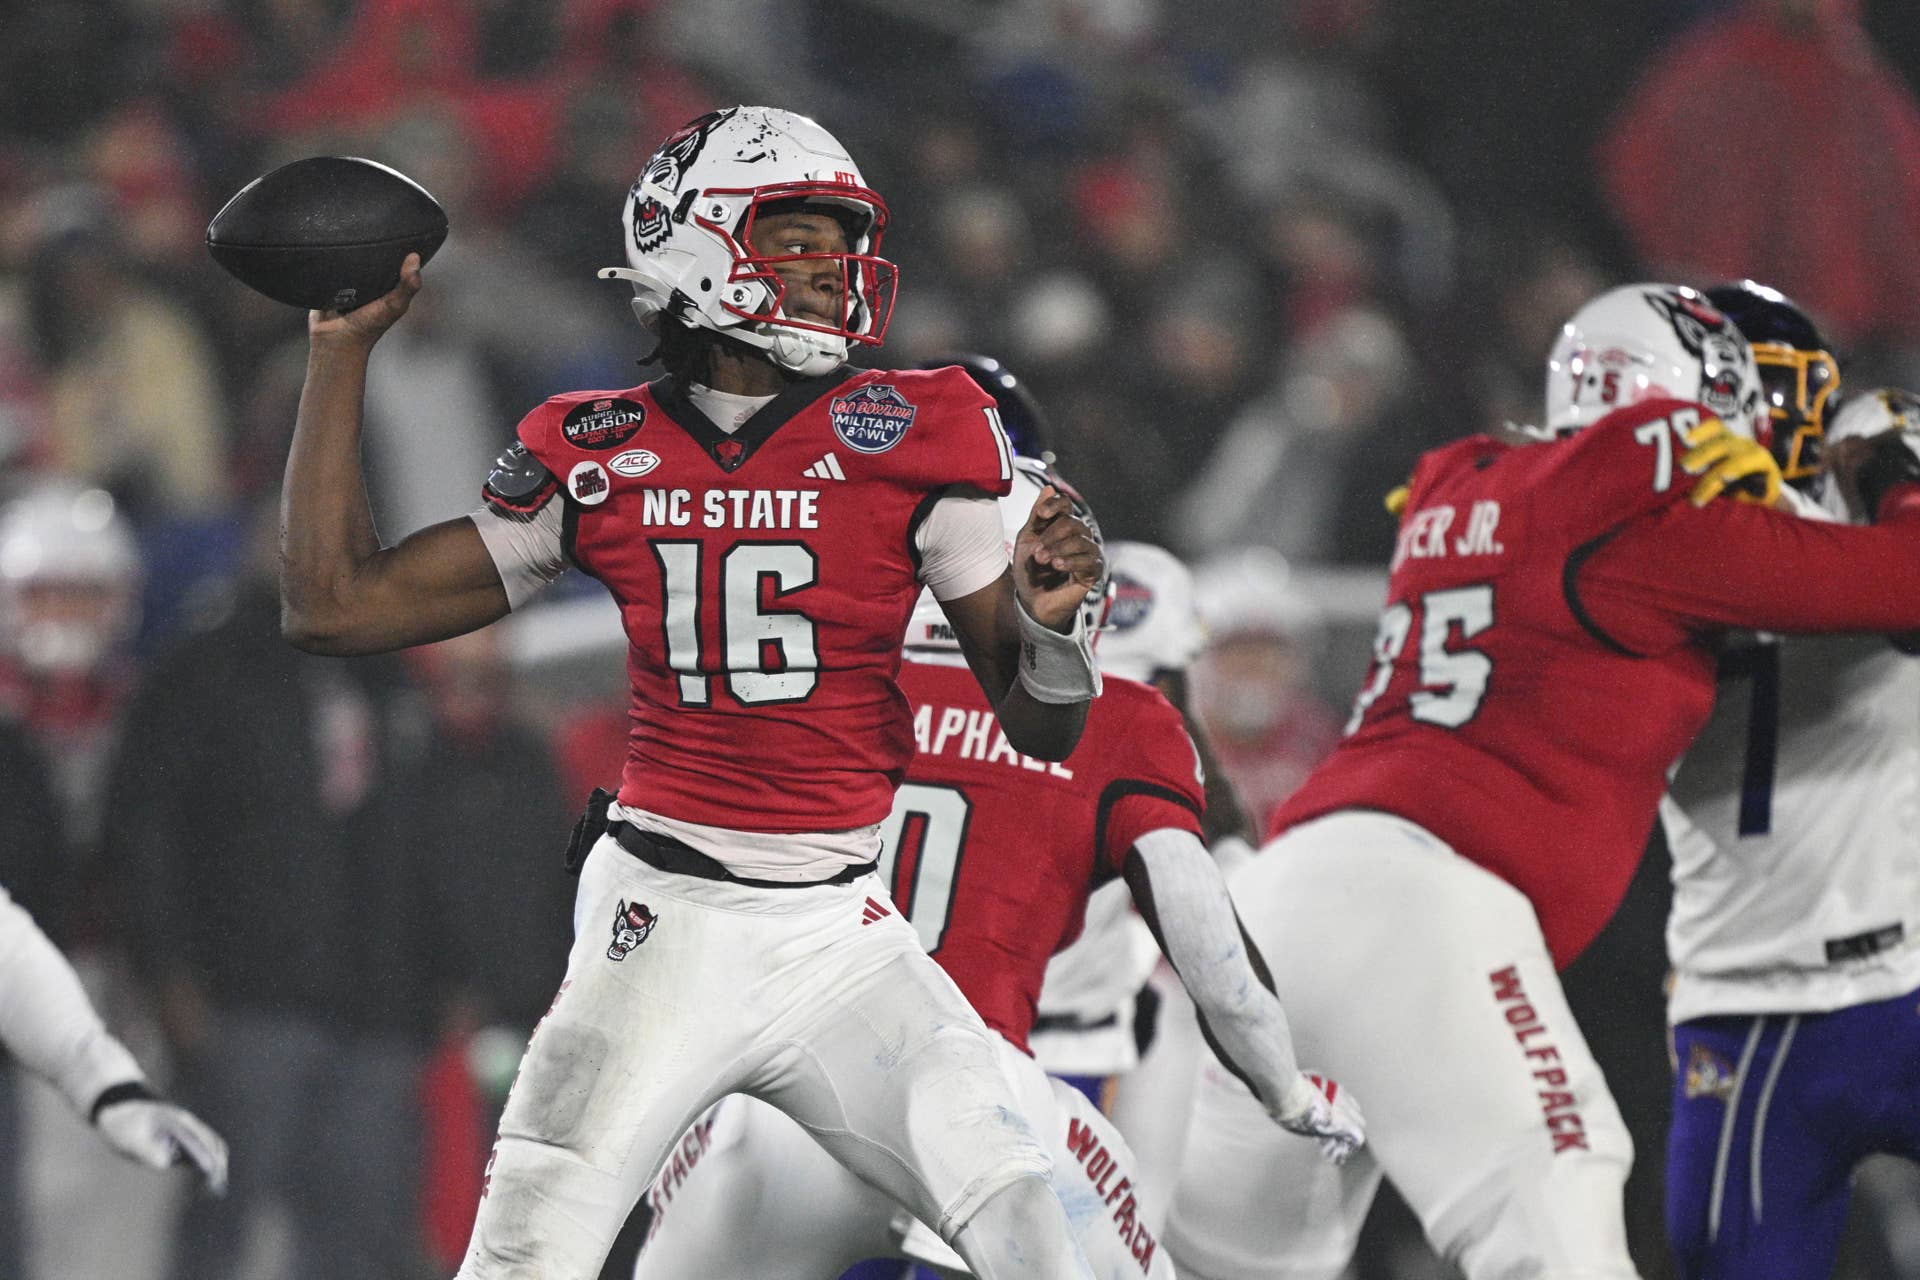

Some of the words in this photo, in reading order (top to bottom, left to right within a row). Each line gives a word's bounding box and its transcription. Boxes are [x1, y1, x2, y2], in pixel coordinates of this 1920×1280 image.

[834, 402, 855, 413] GO
[858, 402, 912, 419] BOWLING
[565, 412, 641, 435] WILSON
[836, 415, 904, 431] MILITARY
[846, 427, 887, 441] BOWL
[618, 456, 650, 466] ACC
[575, 468, 599, 485] PACK
[643, 488, 691, 527] NC
[703, 489, 820, 530] STATE
[1456, 500, 1505, 556] JR.
[646, 538, 823, 709] 16
[1488, 964, 1591, 1156] WOLFPACK
[1066, 1117, 1157, 1276] WOLFPACK
